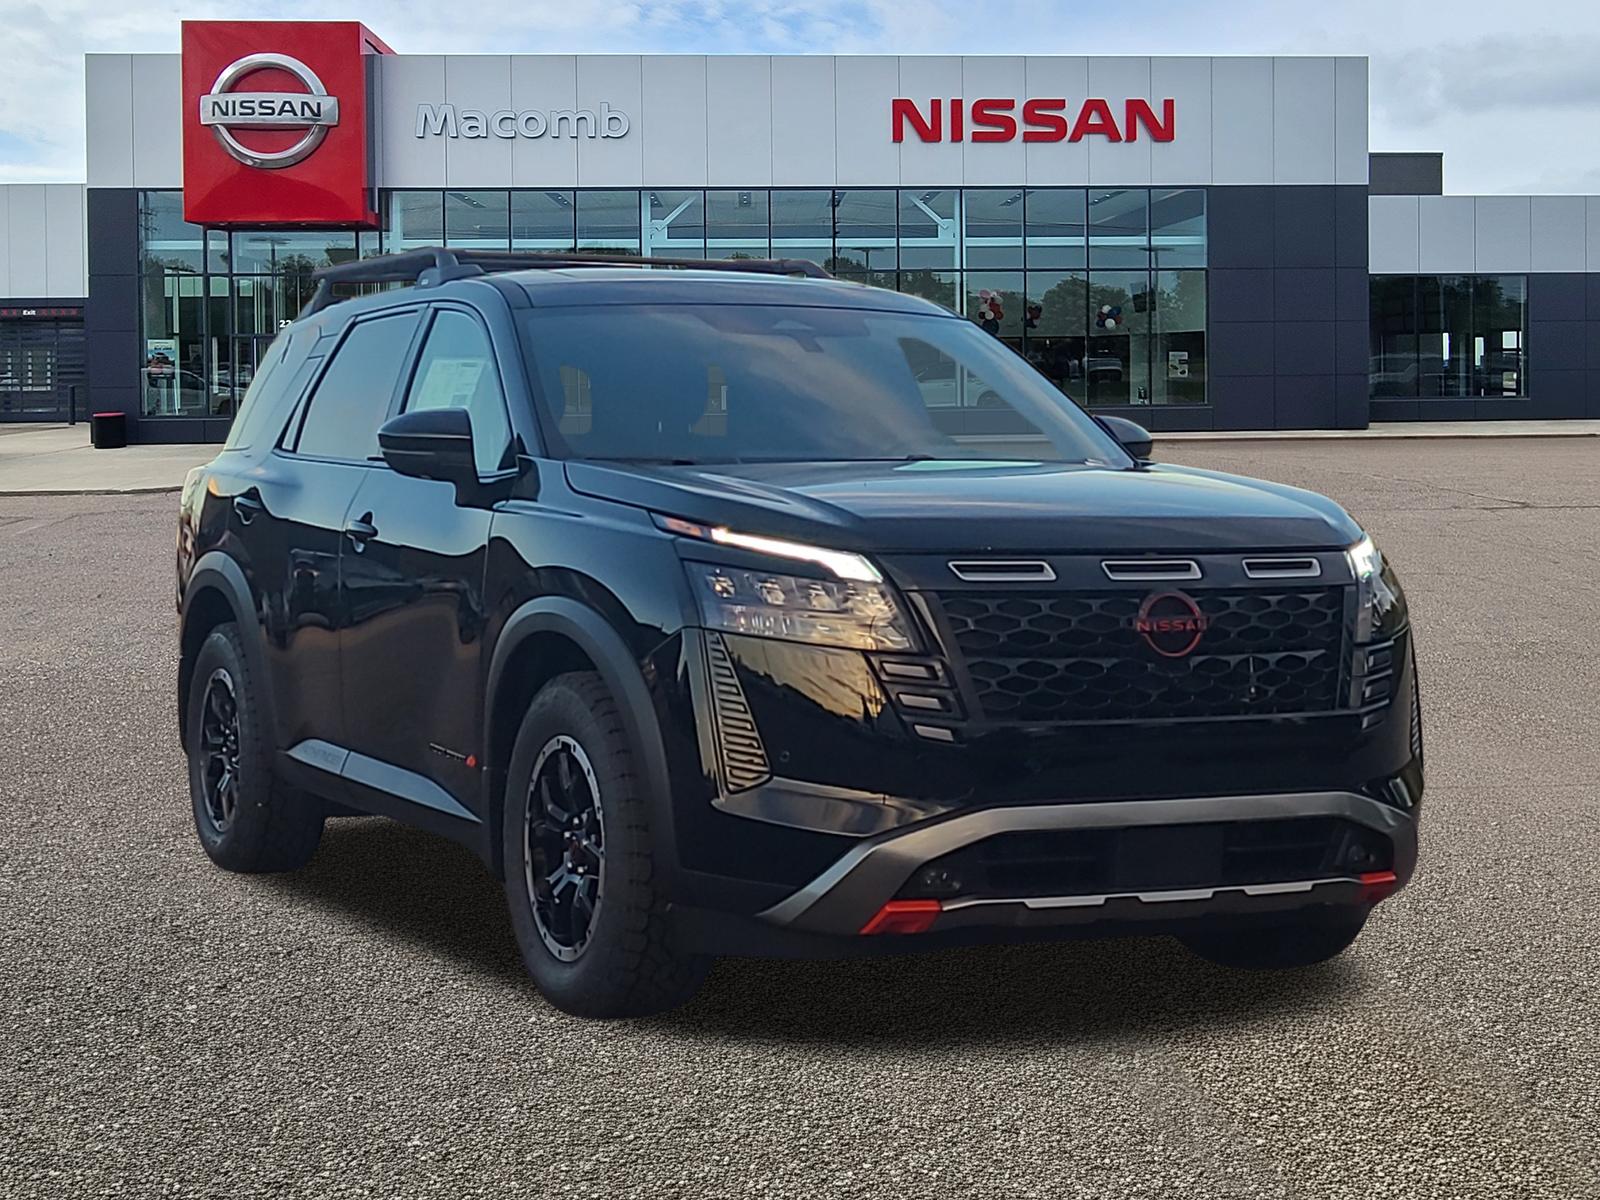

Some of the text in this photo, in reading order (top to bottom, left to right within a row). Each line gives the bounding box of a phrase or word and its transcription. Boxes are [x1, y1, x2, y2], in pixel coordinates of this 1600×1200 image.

[211, 100, 322, 117] NISSAN
[415, 101, 630, 139] Macomb
[892, 98, 1175, 143] NISSAN
[1136, 620, 1207, 632] NISSAN
